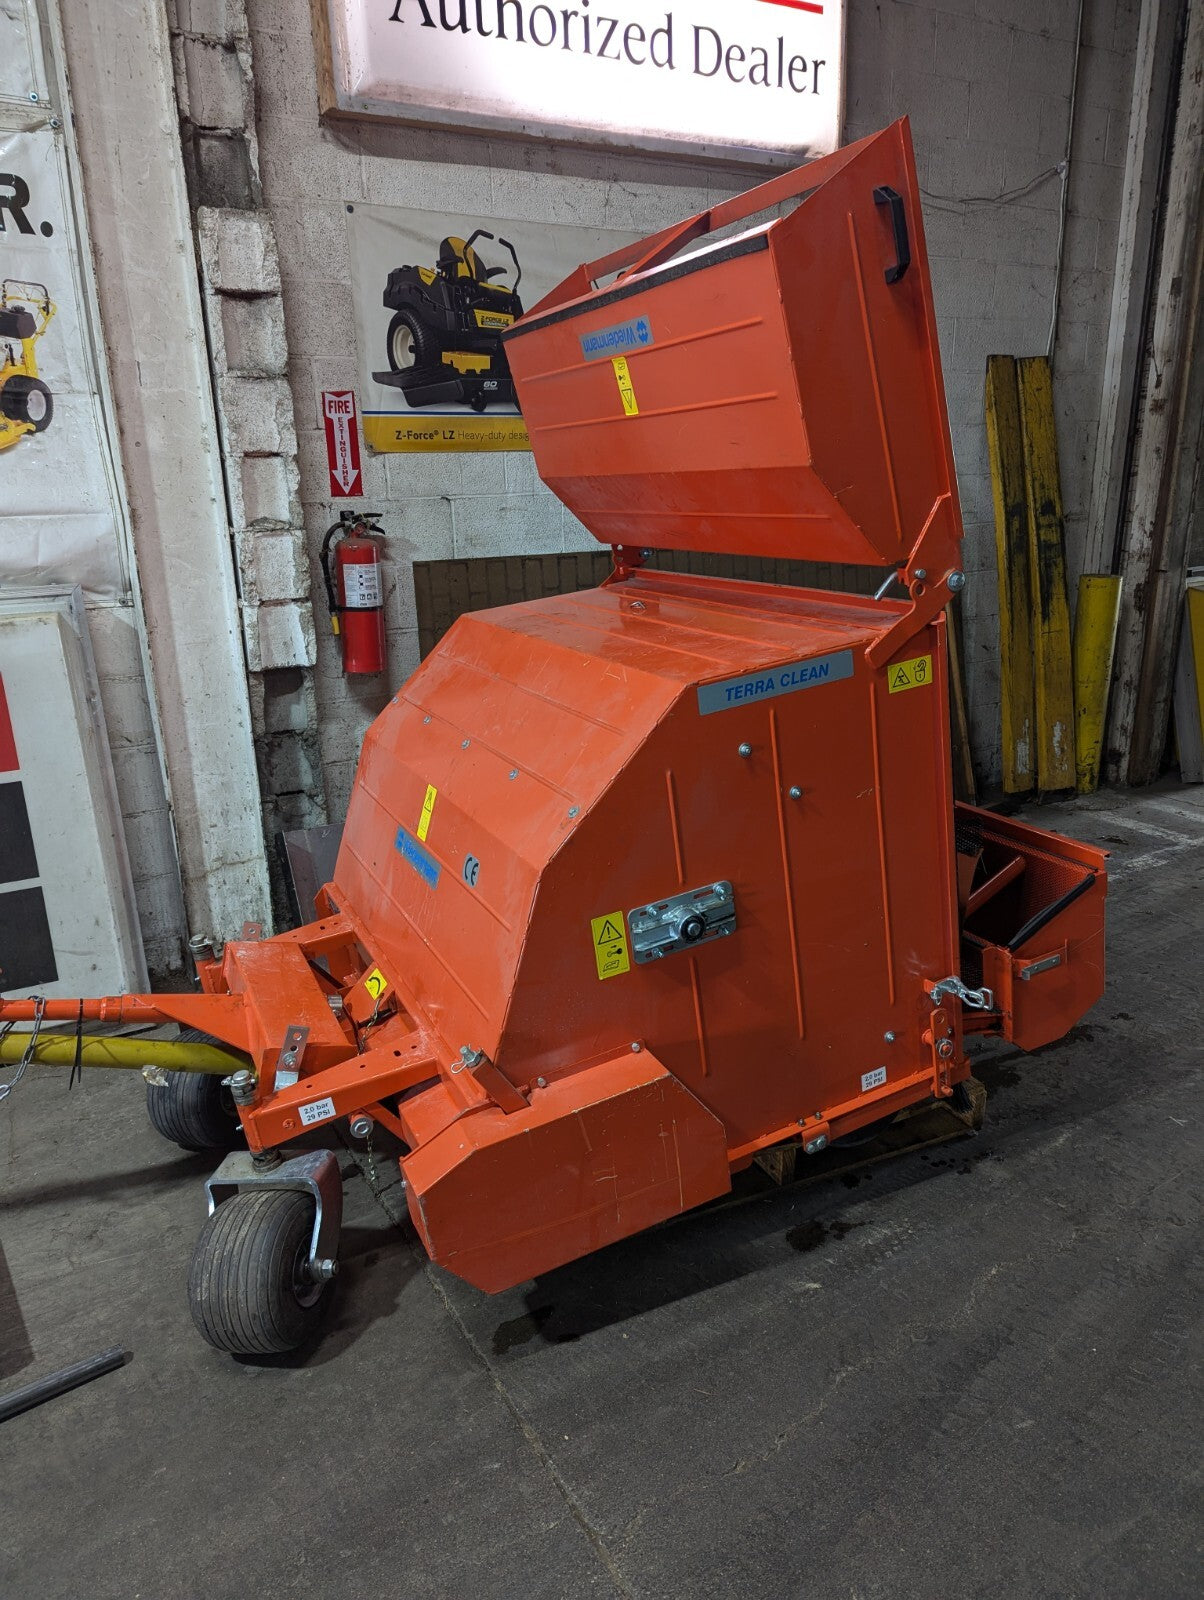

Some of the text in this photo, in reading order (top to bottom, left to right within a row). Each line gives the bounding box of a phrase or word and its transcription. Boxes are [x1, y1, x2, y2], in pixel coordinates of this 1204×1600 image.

[692, 24, 827, 95] Dealer
[582, 326, 638, 353] Wiedenmann
[328, 400, 351, 414] FIRE
[442, 430, 456, 440] LZ
[458, 430, 506, 442] Heavy-duty
[337, 416, 350, 487] EXTINGUISHER
[725, 663, 830, 702] TERRA CLEAN
[318, 1109, 330, 1117] PSI
